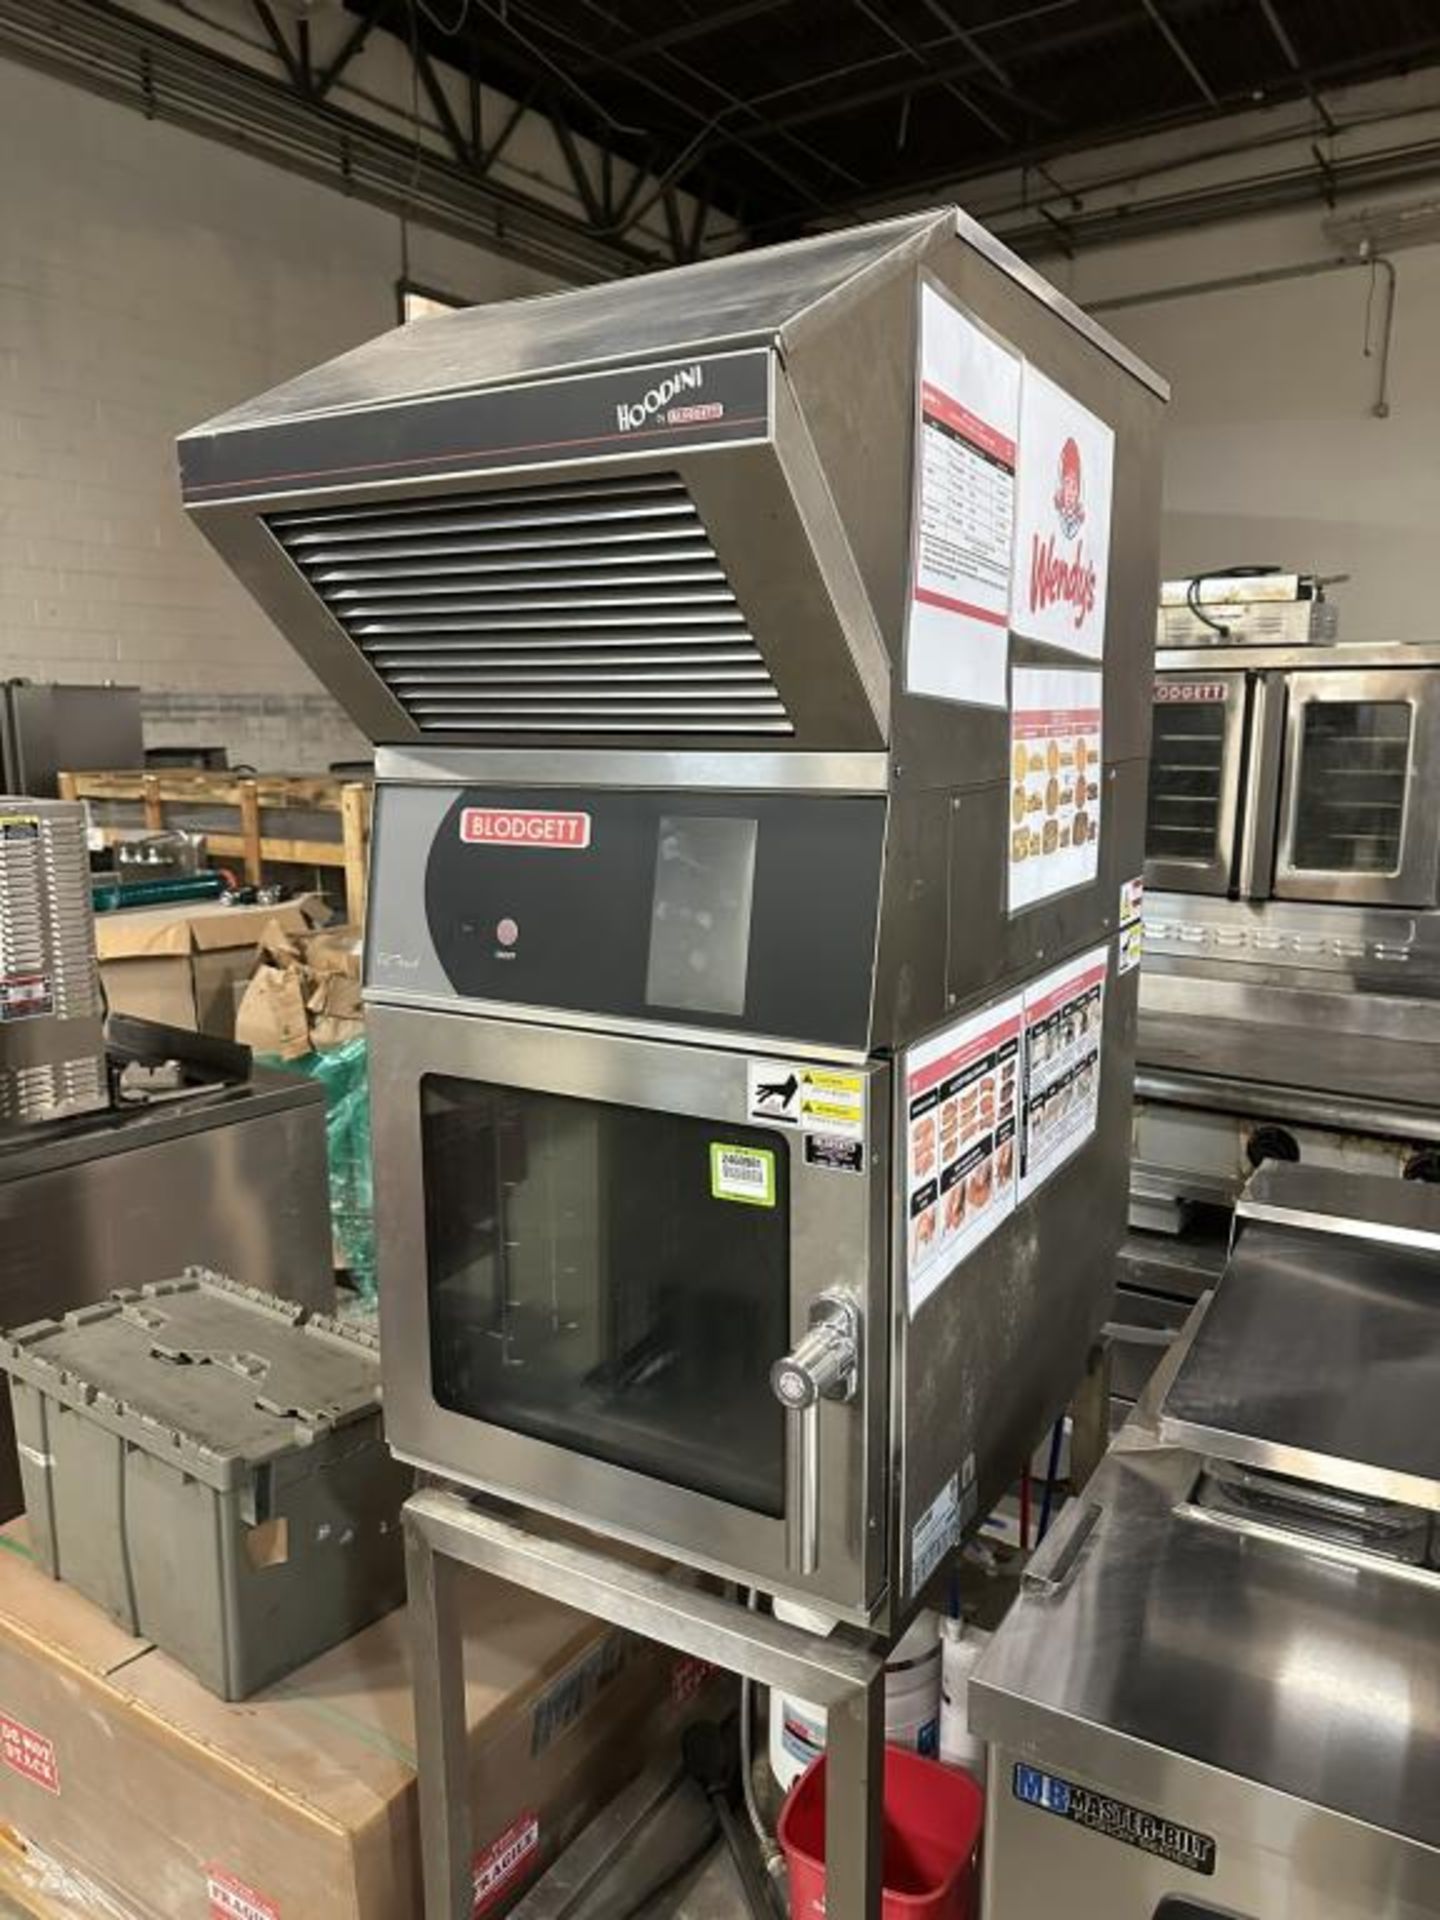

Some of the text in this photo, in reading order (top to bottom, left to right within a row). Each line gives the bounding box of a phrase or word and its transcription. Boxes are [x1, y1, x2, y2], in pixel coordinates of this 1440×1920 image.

[617, 364, 703, 432] HOODINI
[1029, 533, 1095, 629] Wendy's
[1154, 686, 1221, 700] ODGETT
[472, 816, 578, 841] BLODGETT
[6, 1742, 54, 1781] STACK
[22, 1734, 49, 1761] NOT
